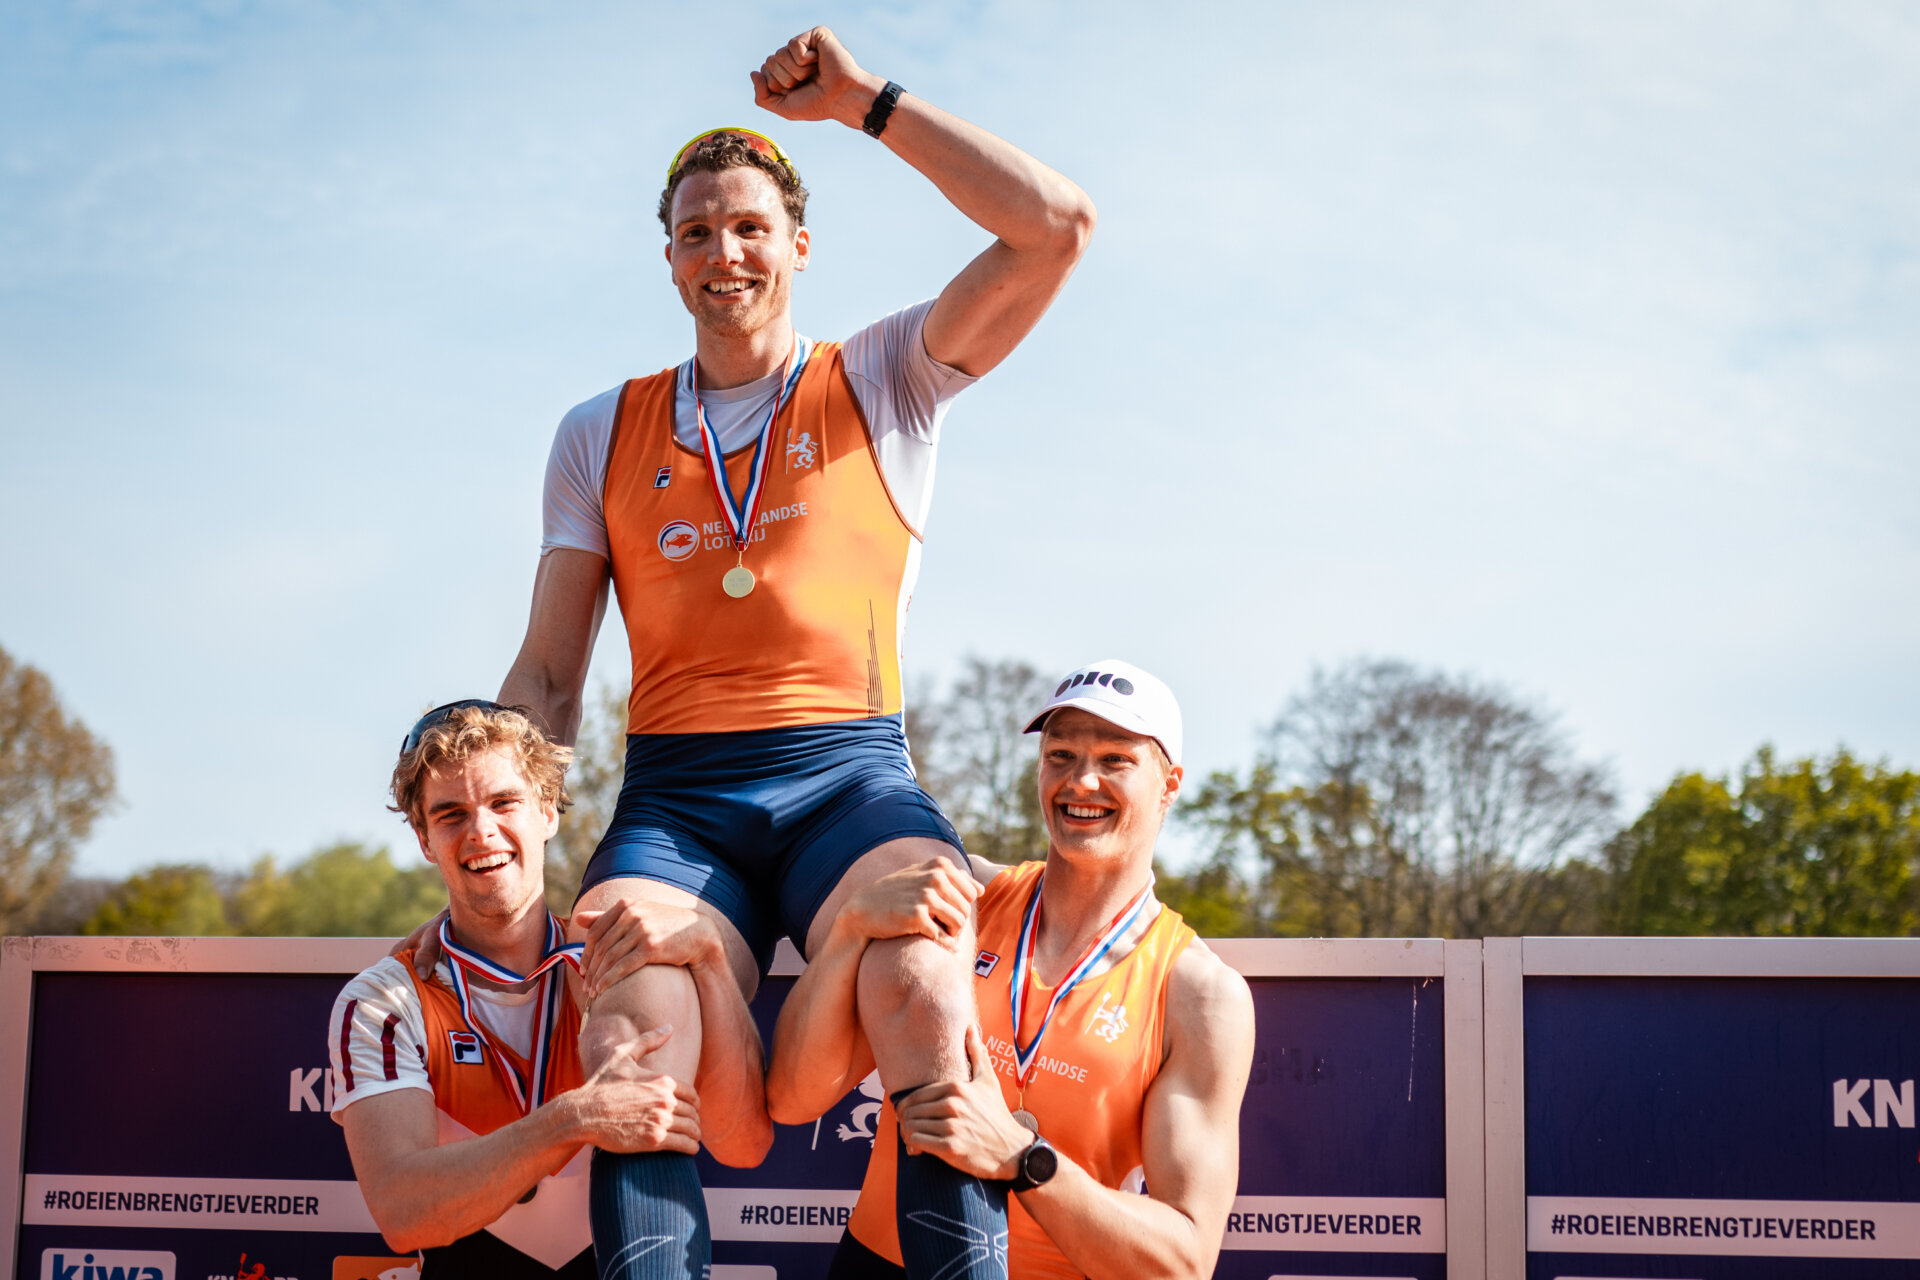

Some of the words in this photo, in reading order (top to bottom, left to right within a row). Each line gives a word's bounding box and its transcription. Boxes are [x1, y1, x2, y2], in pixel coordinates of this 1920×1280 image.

[703, 502, 808, 535] NEANDSE
[704, 528, 766, 550] LOTIJ
[984, 1035, 1088, 1083] NEDANDSE
[1832, 1078, 1916, 1128] KN
[44, 1190, 319, 1216] #ROEIENBRENGTJEVERDER
[740, 1204, 856, 1226] #ROEIENB
[1551, 1214, 1877, 1241] #ROEIENBRENGTJEVERDER
